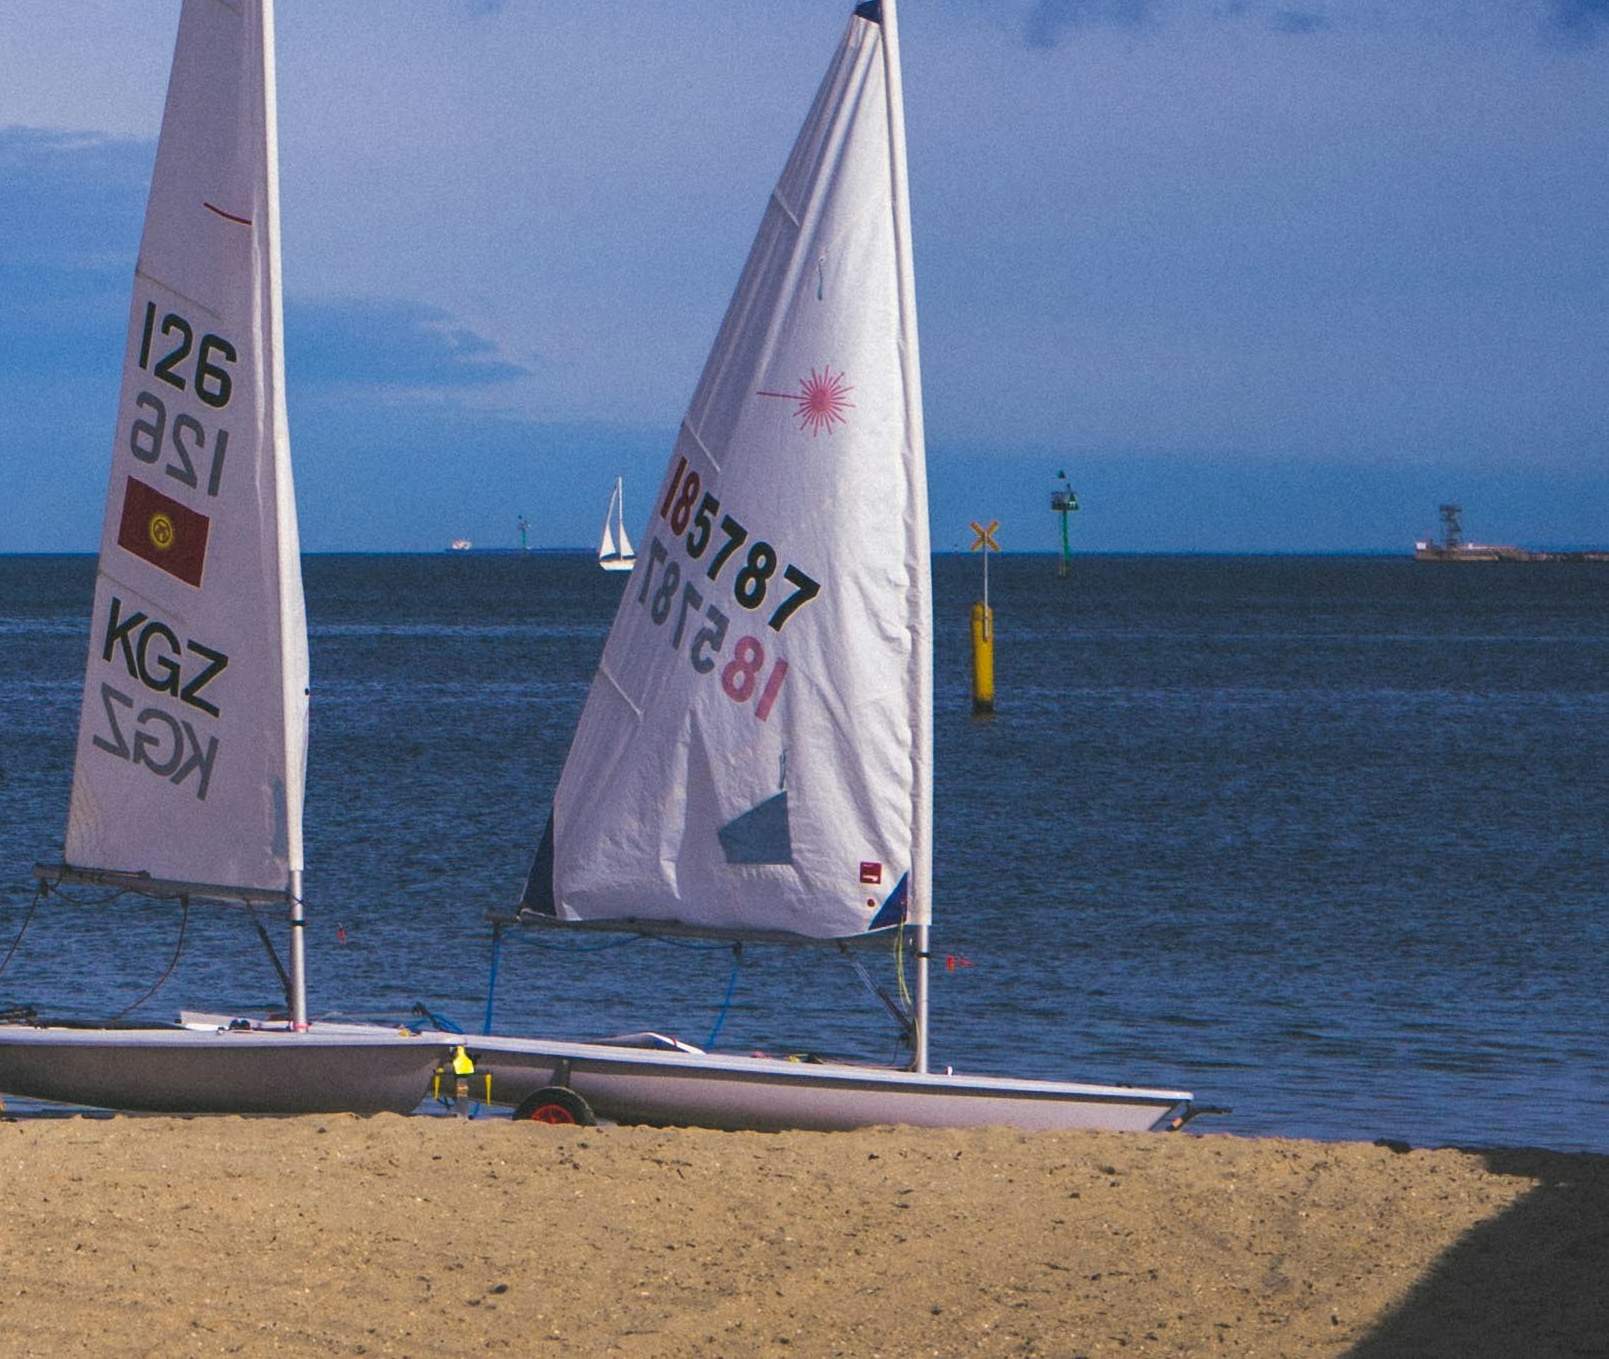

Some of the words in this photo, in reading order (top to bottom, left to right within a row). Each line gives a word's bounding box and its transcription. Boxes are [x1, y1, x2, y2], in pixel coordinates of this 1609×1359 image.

[139, 300, 237, 409] 126
[661, 456, 821, 632] 185787
[102, 596, 229, 718] KGZ
